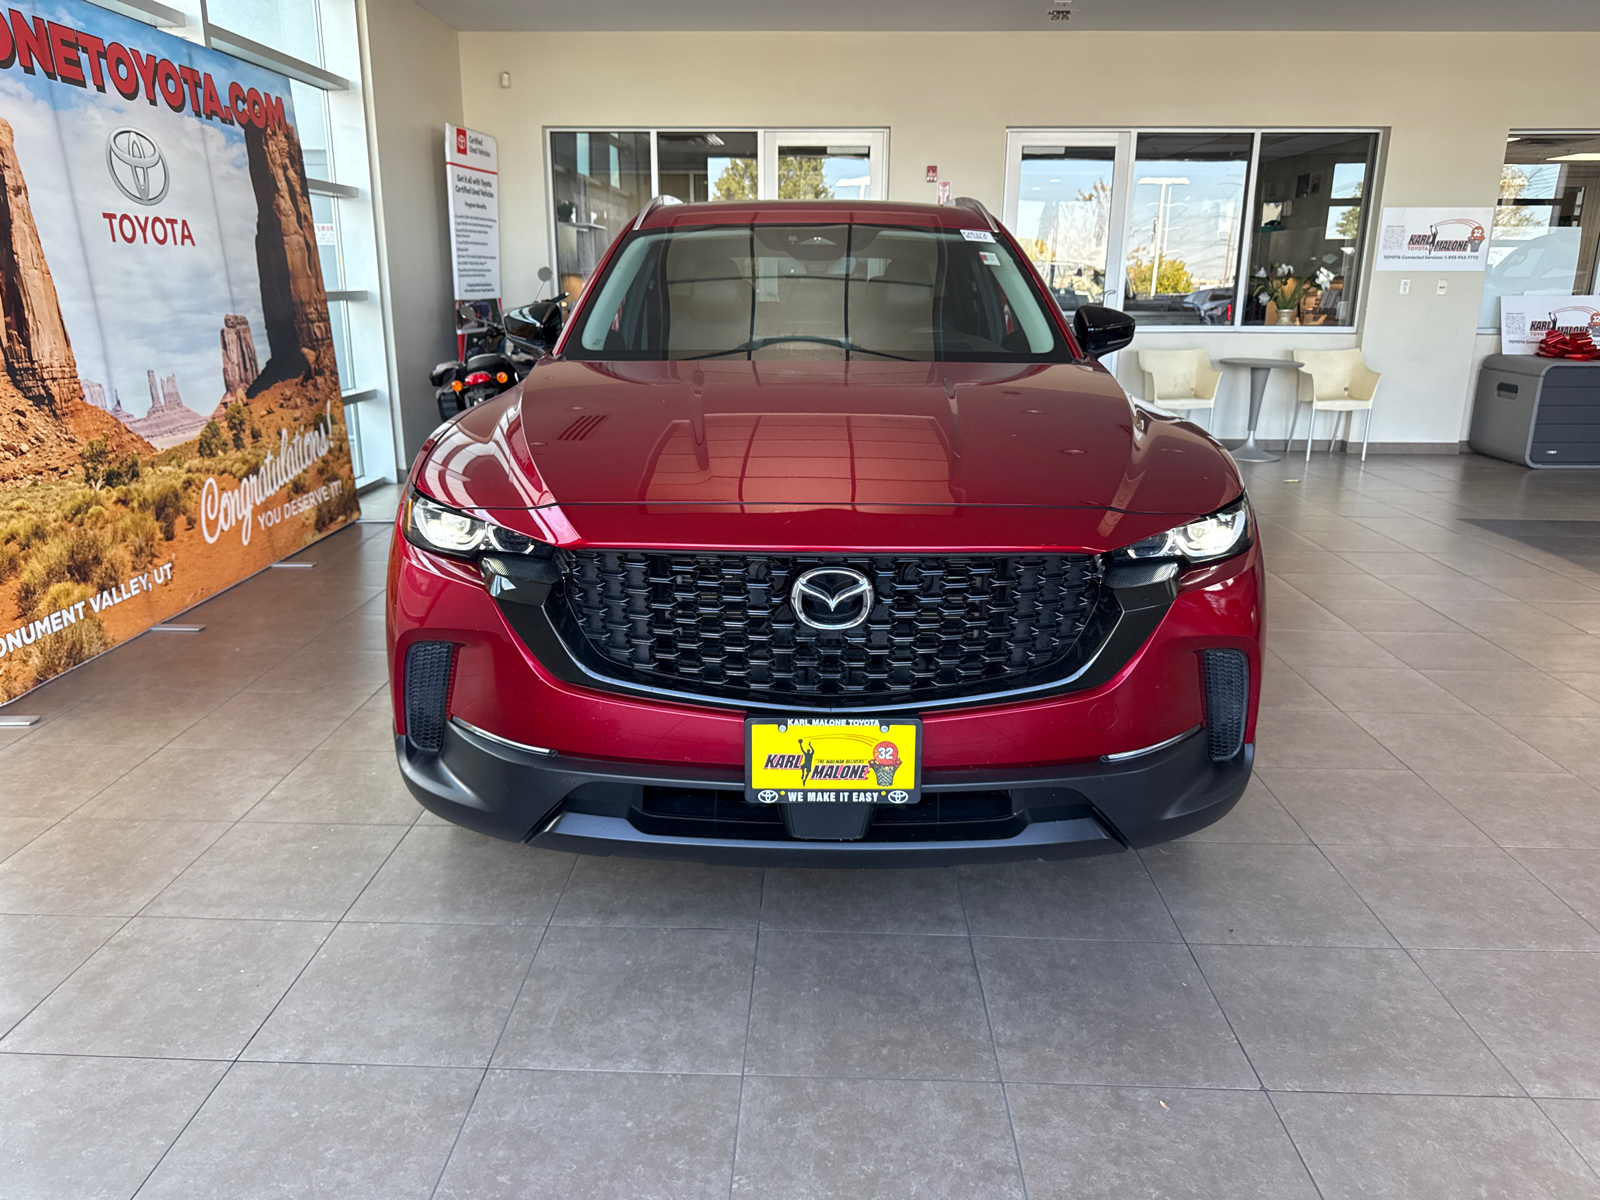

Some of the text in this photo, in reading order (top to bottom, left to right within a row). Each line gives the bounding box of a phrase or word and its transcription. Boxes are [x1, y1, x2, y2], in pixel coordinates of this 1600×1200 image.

[481, 178, 492, 188] Toyota
[455, 184, 471, 195] Certified
[481, 188, 494, 198] Vehicles
[102, 212, 196, 247] TOYOTA
[1473, 228, 1482, 237] 32
[1408, 234, 1431, 245] KARL
[1434, 240, 1470, 252] MALONE
[1530, 320, 1552, 331] KARL
[201, 399, 334, 546] Congratulations!
[257, 479, 343, 530] YOU DESERVE IT!
[89, 573, 153, 614] VALLEY,
[153, 562, 173, 584] UT
[878, 746, 894, 760] 32
[763, 754, 803, 770] KARL
[810, 765, 869, 780] MALONE
[788, 792, 878, 802] WE MAKE IT EASY
